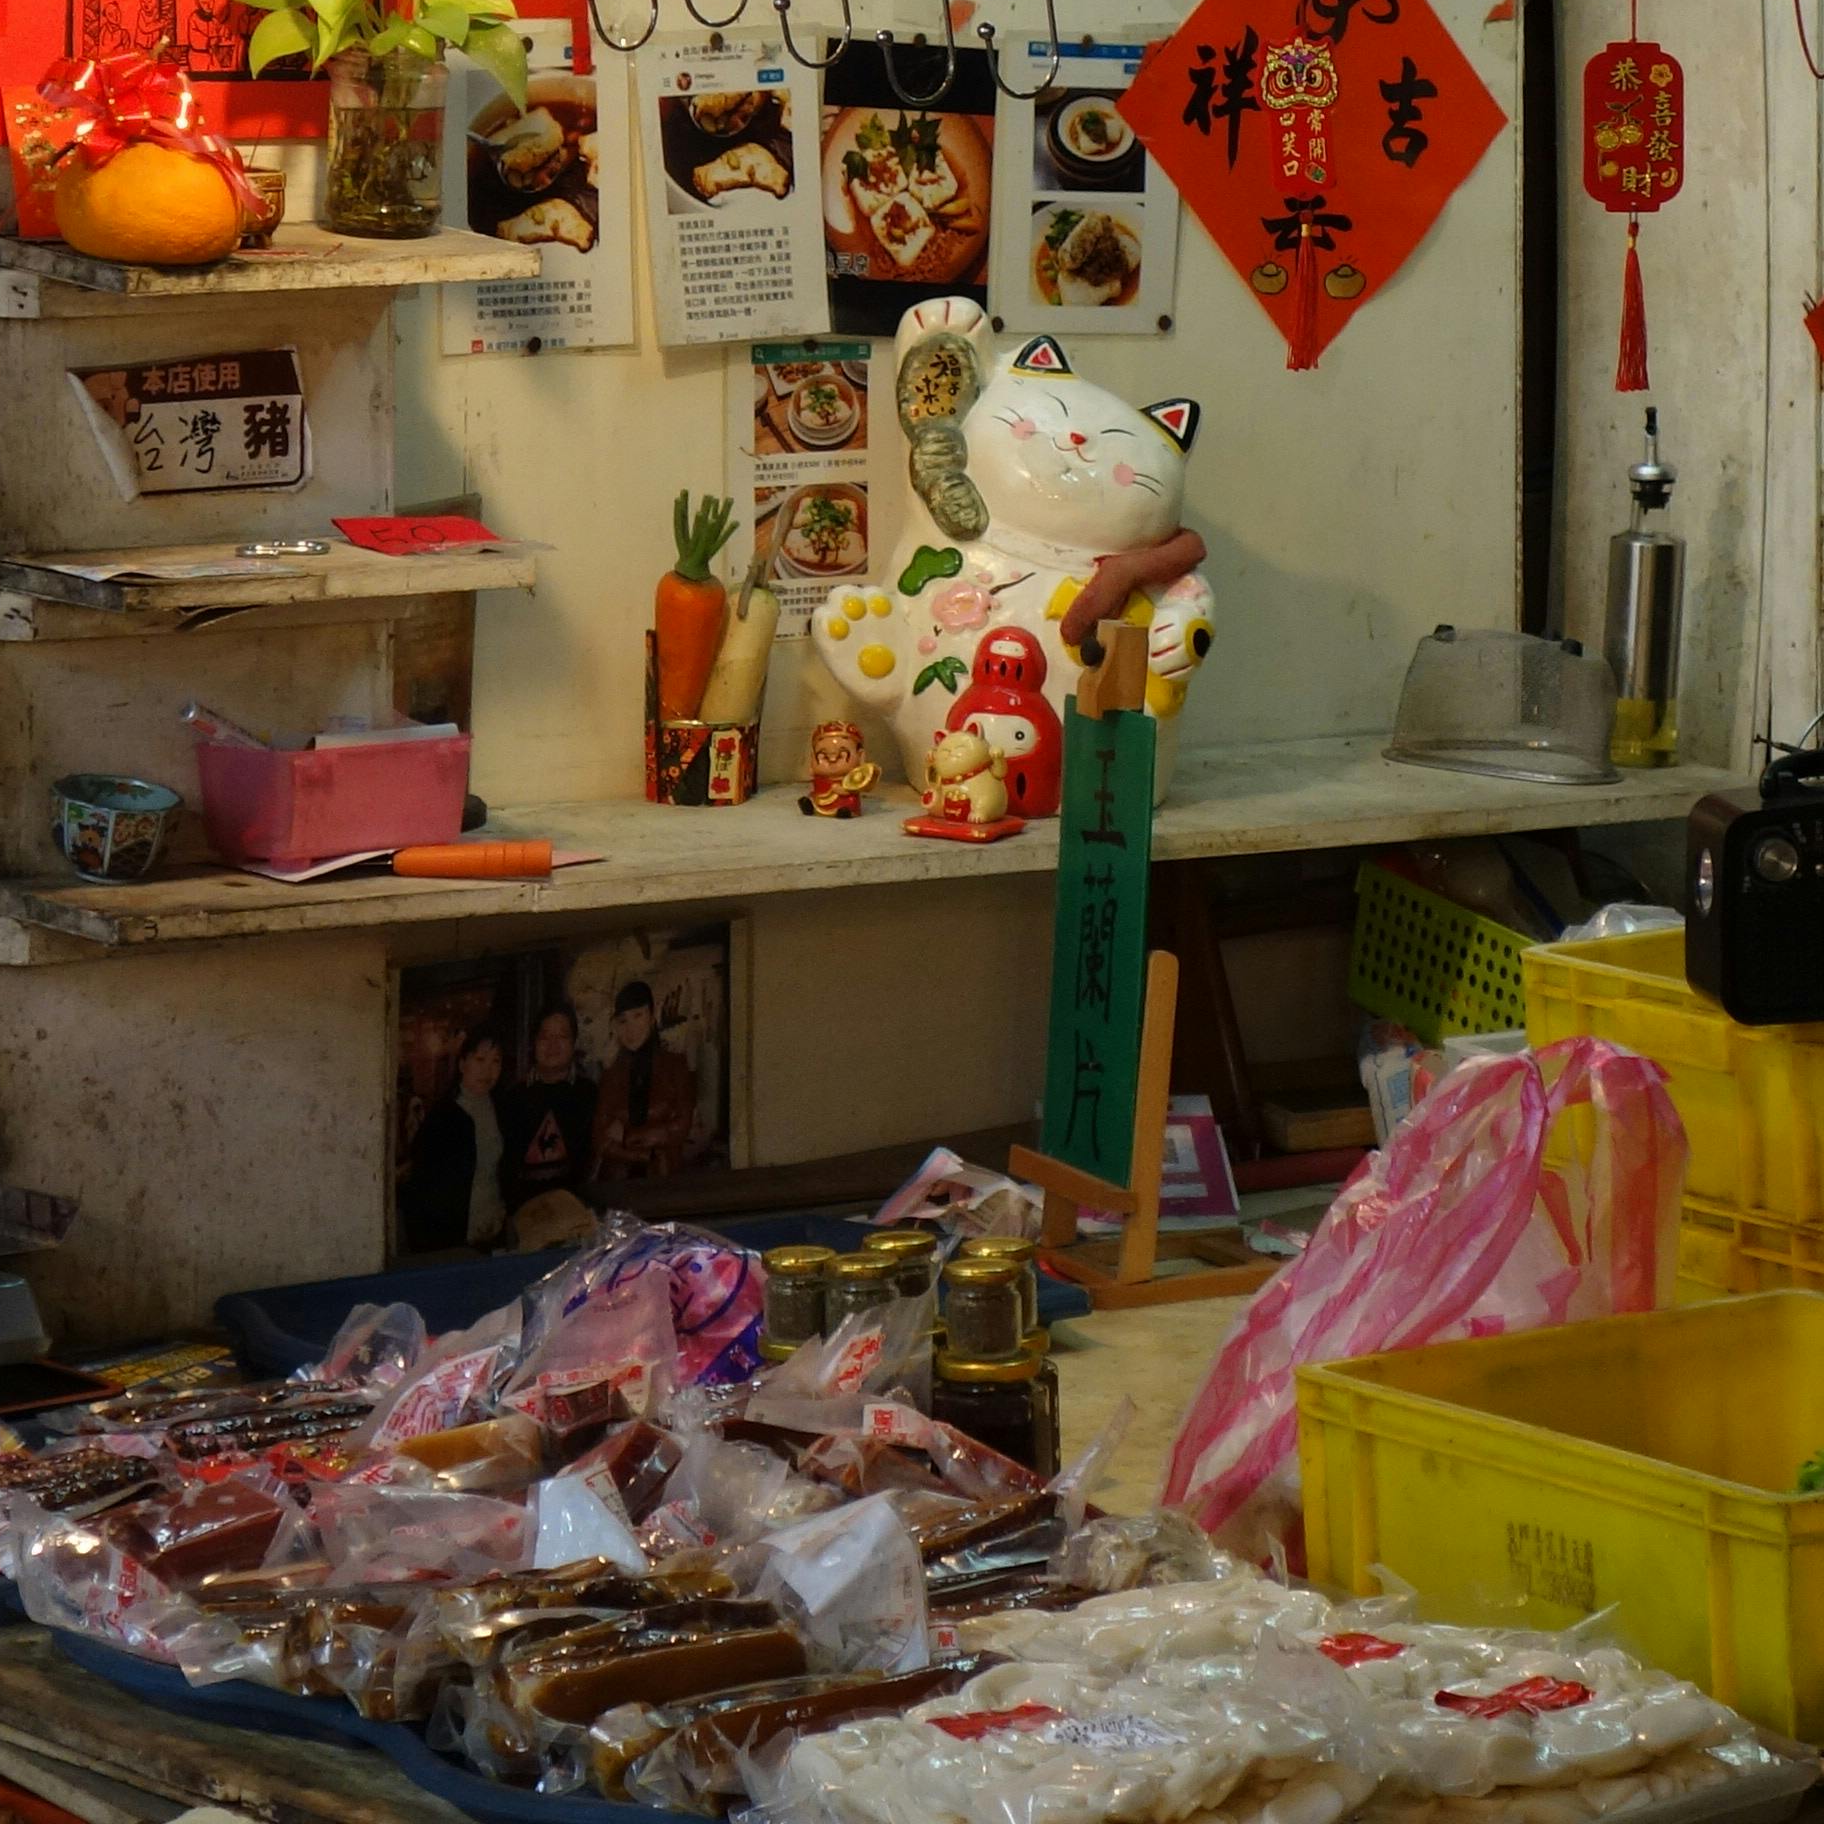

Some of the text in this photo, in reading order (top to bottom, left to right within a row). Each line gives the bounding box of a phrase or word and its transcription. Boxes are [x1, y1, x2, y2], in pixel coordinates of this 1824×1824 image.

[1609, 57, 1682, 198] 恭喜發財
[142, 360, 240, 396] 本店使用
[133, 400, 291, 476] 台灣豬
[1062, 749, 1125, 1163] 玉蘭片
